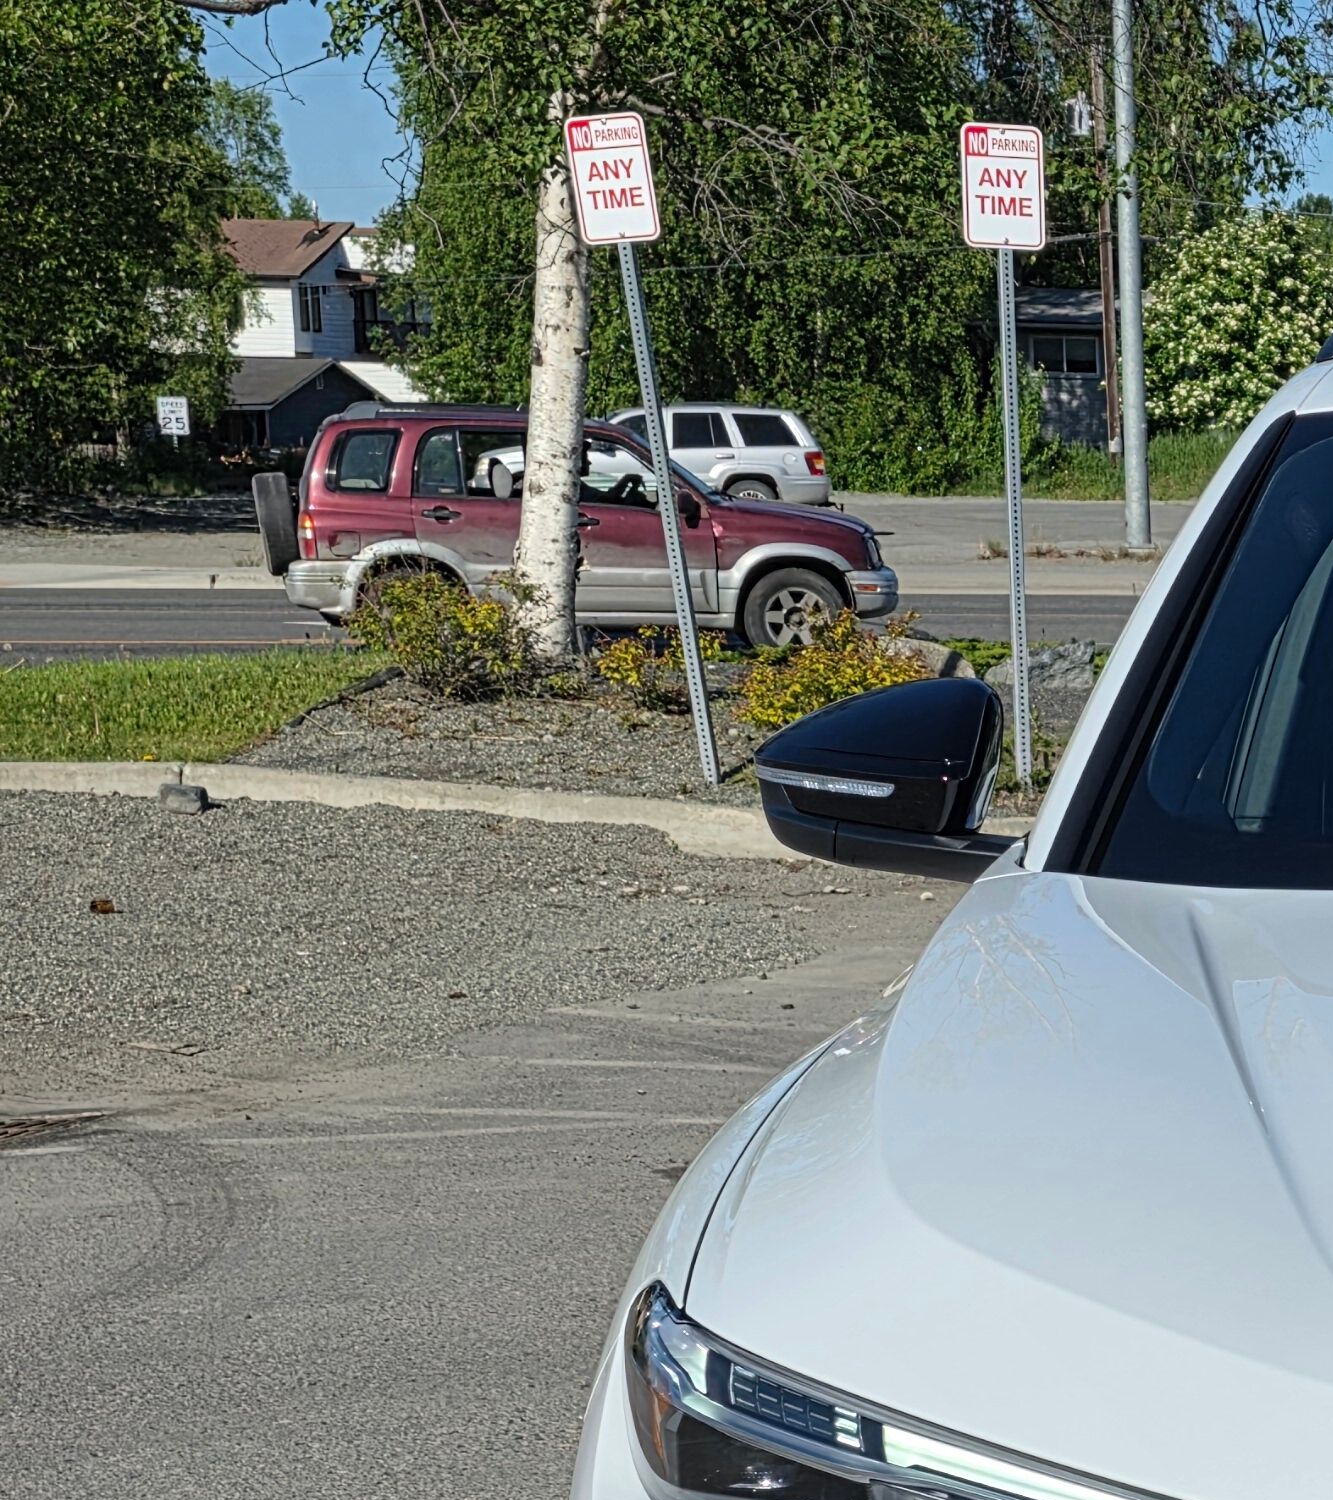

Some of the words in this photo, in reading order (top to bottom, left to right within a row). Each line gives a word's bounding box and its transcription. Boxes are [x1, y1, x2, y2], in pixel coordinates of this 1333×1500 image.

[572, 125, 592, 149] NO
[594, 126, 639, 142] PARKING
[968, 132, 988, 154] NO
[991, 138, 1036, 153] PARKING
[588, 158, 633, 182] ANY
[979, 167, 1028, 189] ANY
[586, 186, 645, 210] TIME
[975, 194, 1034, 217] TIME
[160, 416, 186, 430] 25
